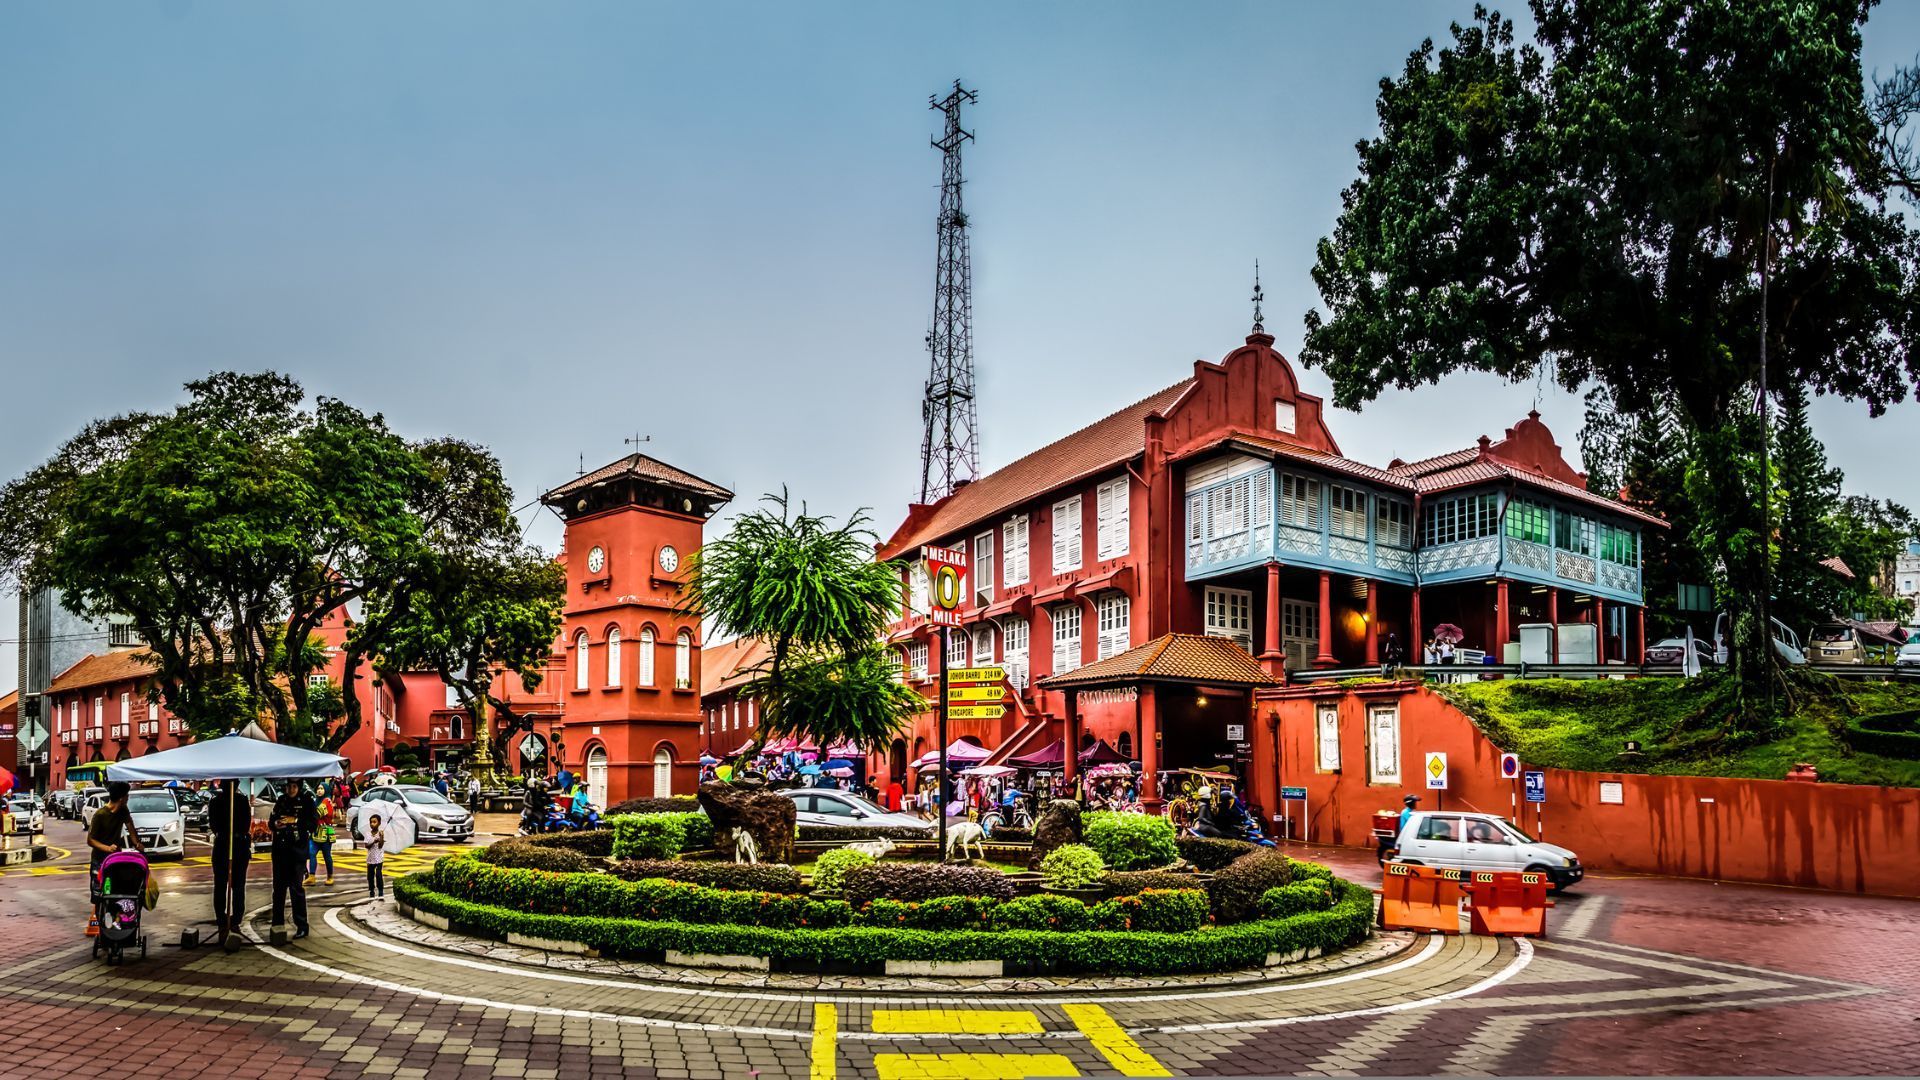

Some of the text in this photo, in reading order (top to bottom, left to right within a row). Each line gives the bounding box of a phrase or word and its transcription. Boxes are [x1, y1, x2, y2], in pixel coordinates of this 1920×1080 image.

[929, 547, 967, 566] MELAKA
[933, 609, 962, 626] MILE
[950, 671, 964, 680] JOHOR
[965, 671, 980, 679] BAHRU
[994, 670, 1001, 678] KM
[950, 690, 963, 698] MUAR
[994, 689, 1001, 697] KM
[950, 708, 974, 716] SINGAPORE
[994, 708, 1001, 716] KM
